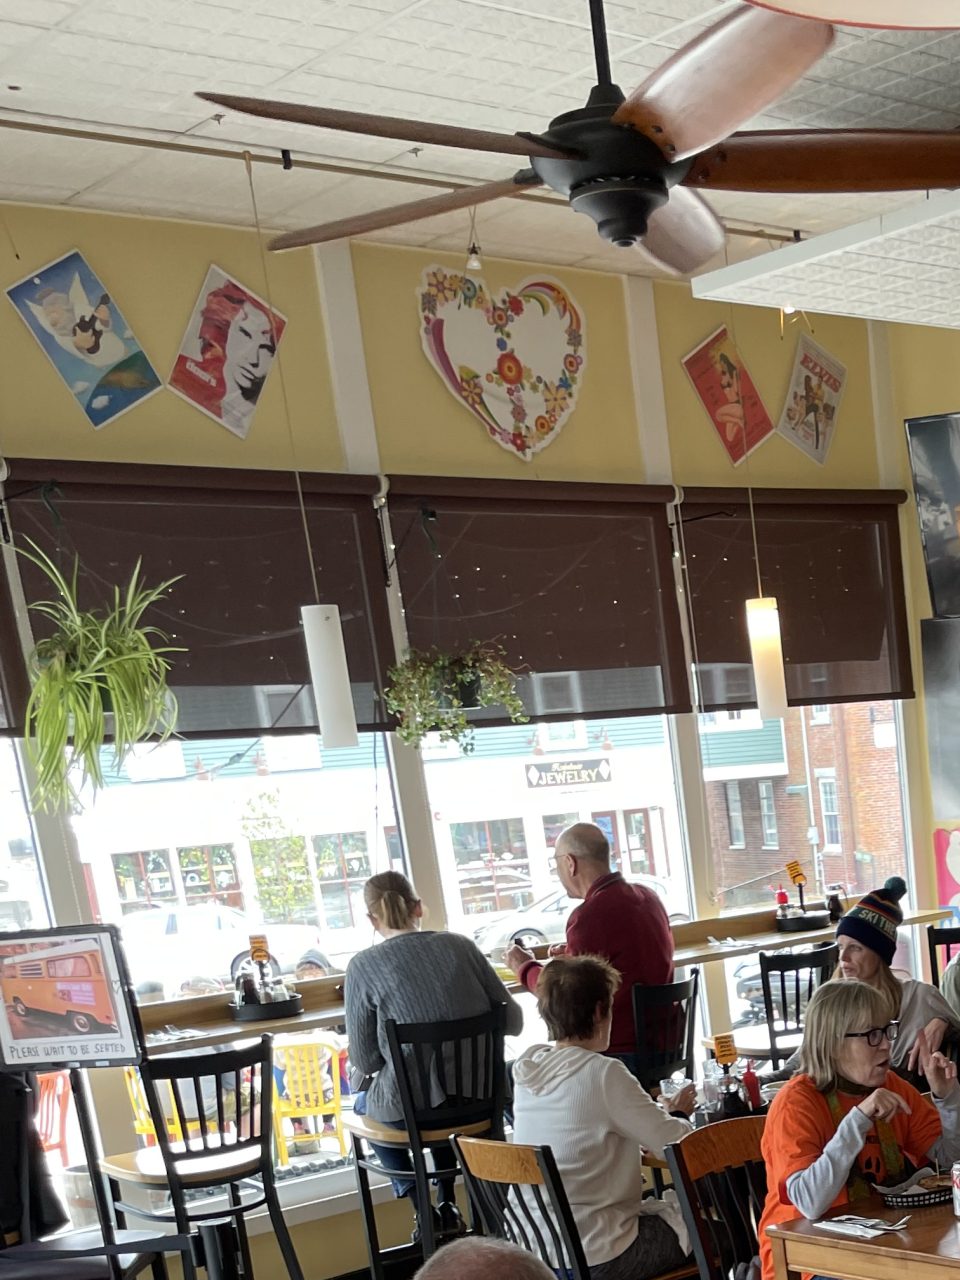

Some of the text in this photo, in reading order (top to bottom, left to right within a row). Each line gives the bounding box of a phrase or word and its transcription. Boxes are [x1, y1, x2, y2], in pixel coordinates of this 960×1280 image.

[800, 353, 841, 393] ELVIS
[538, 768, 600, 785] JEWELRY
[859, 910, 879, 924] SKI
[9, 1043, 126, 1059] PLEASE WAIT TO BE SEATED
